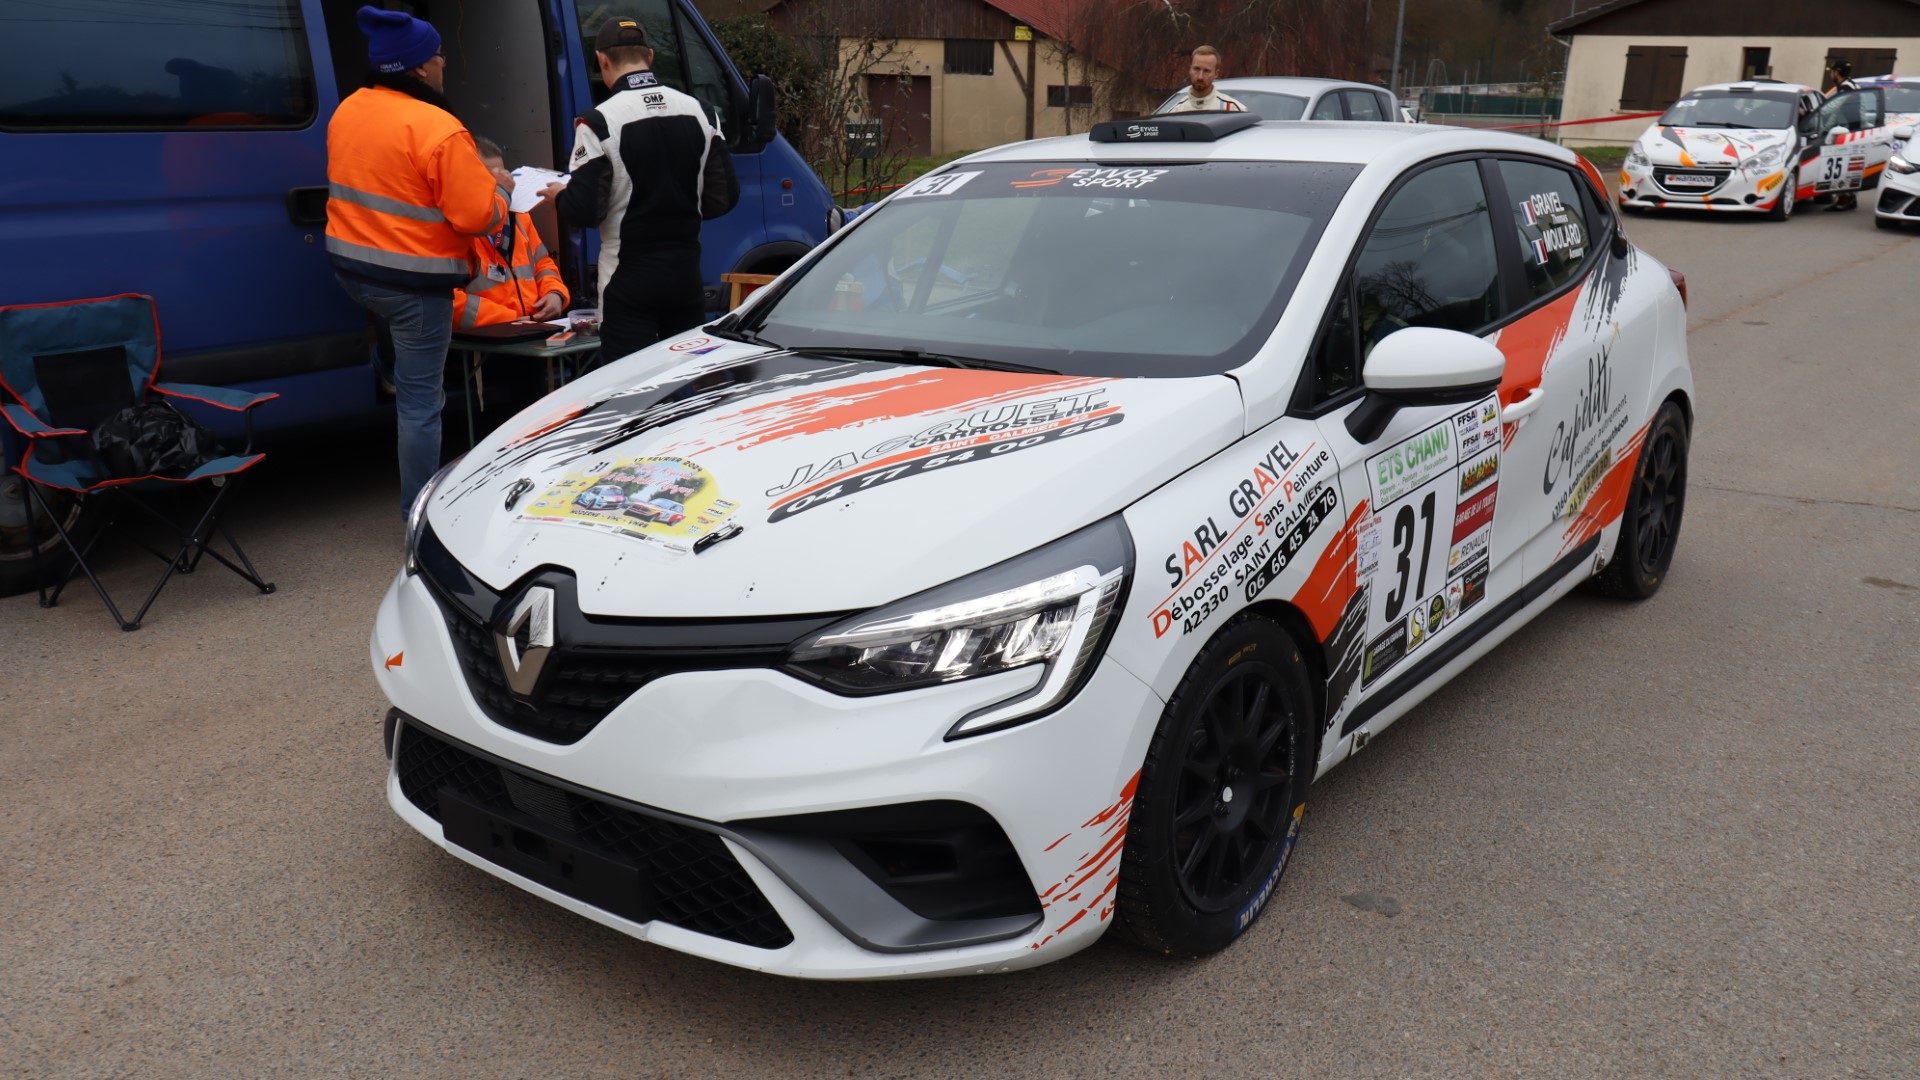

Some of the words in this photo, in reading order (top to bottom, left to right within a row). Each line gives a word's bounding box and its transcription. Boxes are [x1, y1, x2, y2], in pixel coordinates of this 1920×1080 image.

[643, 94, 664, 104] OMP
[912, 172, 958, 195] 31
[1072, 178, 1160, 189] SPORT
[1824, 157, 1843, 180] 35
[1530, 191, 1565, 216] GRAYEL
[1543, 223, 1581, 253] MOULARD
[909, 400, 1111, 449] CARROSSERIE
[929, 437, 978, 454] SAINT
[989, 420, 1060, 441] GALMIER
[765, 388, 1107, 496] JACQUET
[1376, 451, 1404, 485] ETS
[1404, 424, 1450, 469] CHANU
[589, 461, 610, 473] 31
[682, 459, 703, 472] 2024
[786, 485, 843, 514] 04
[859, 466, 911, 488] 77
[920, 450, 975, 469] 54
[989, 435, 1046, 455] 00
[1058, 415, 1112, 437] 55
[1165, 516, 1229, 589] SARL
[1229, 440, 1300, 519] GRAYEL
[1455, 506, 1471, 527] GARAGE
[1552, 491, 1568, 521] 42160
[1153, 535, 1254, 639] Débosselage
[1254, 499, 1285, 536] Sans
[1283, 450, 1329, 502] Peinture
[1182, 585, 1229, 636] 42330
[1234, 539, 1272, 587] SAINT
[1274, 481, 1323, 539] GALMIER
[1249, 572, 1266, 596] 06
[1271, 551, 1287, 575] 66
[1289, 530, 1303, 552] 45
[1306, 511, 1320, 533] 24
[1319, 490, 1337, 514] 76
[1385, 491, 1436, 623] 31
[1460, 528, 1490, 559] RENAULT
